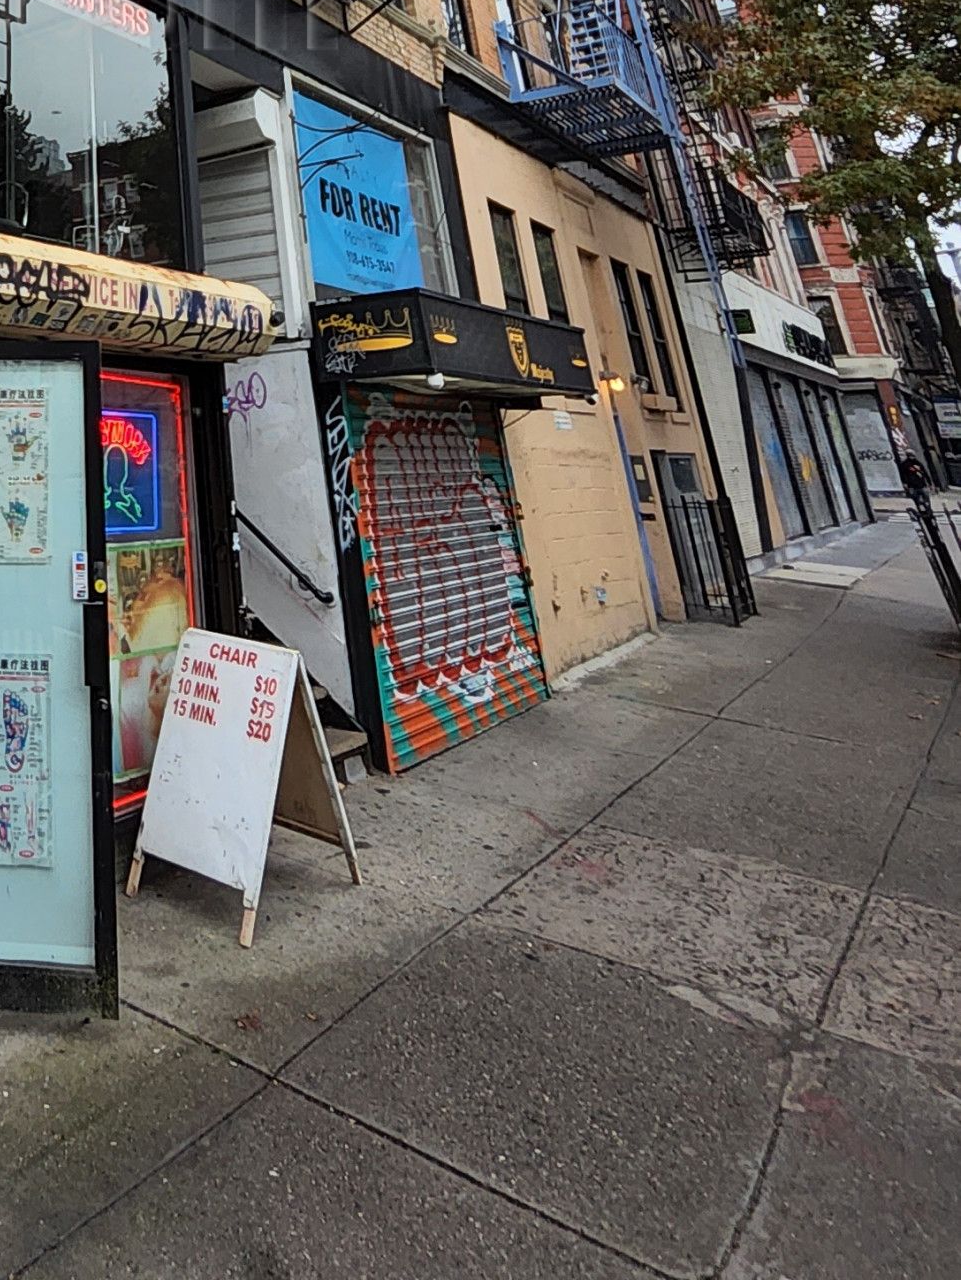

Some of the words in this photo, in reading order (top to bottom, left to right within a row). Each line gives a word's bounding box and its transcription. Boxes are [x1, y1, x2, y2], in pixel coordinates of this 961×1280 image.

[319, 177, 357, 223] FOR
[359, 192, 402, 237] RENT
[180, 656, 189, 673] 5
[191, 659, 218, 681] MIN.
[254, 674, 278, 696] $10
[209, 642, 258, 669] CHAIR
[177, 677, 192, 696] 10
[193, 681, 221, 705] MIN.
[250, 696, 276, 720] $15
[173, 698, 188, 718] 15
[188, 702, 217, 727] MIN.
[246, 719, 272, 743] $20
